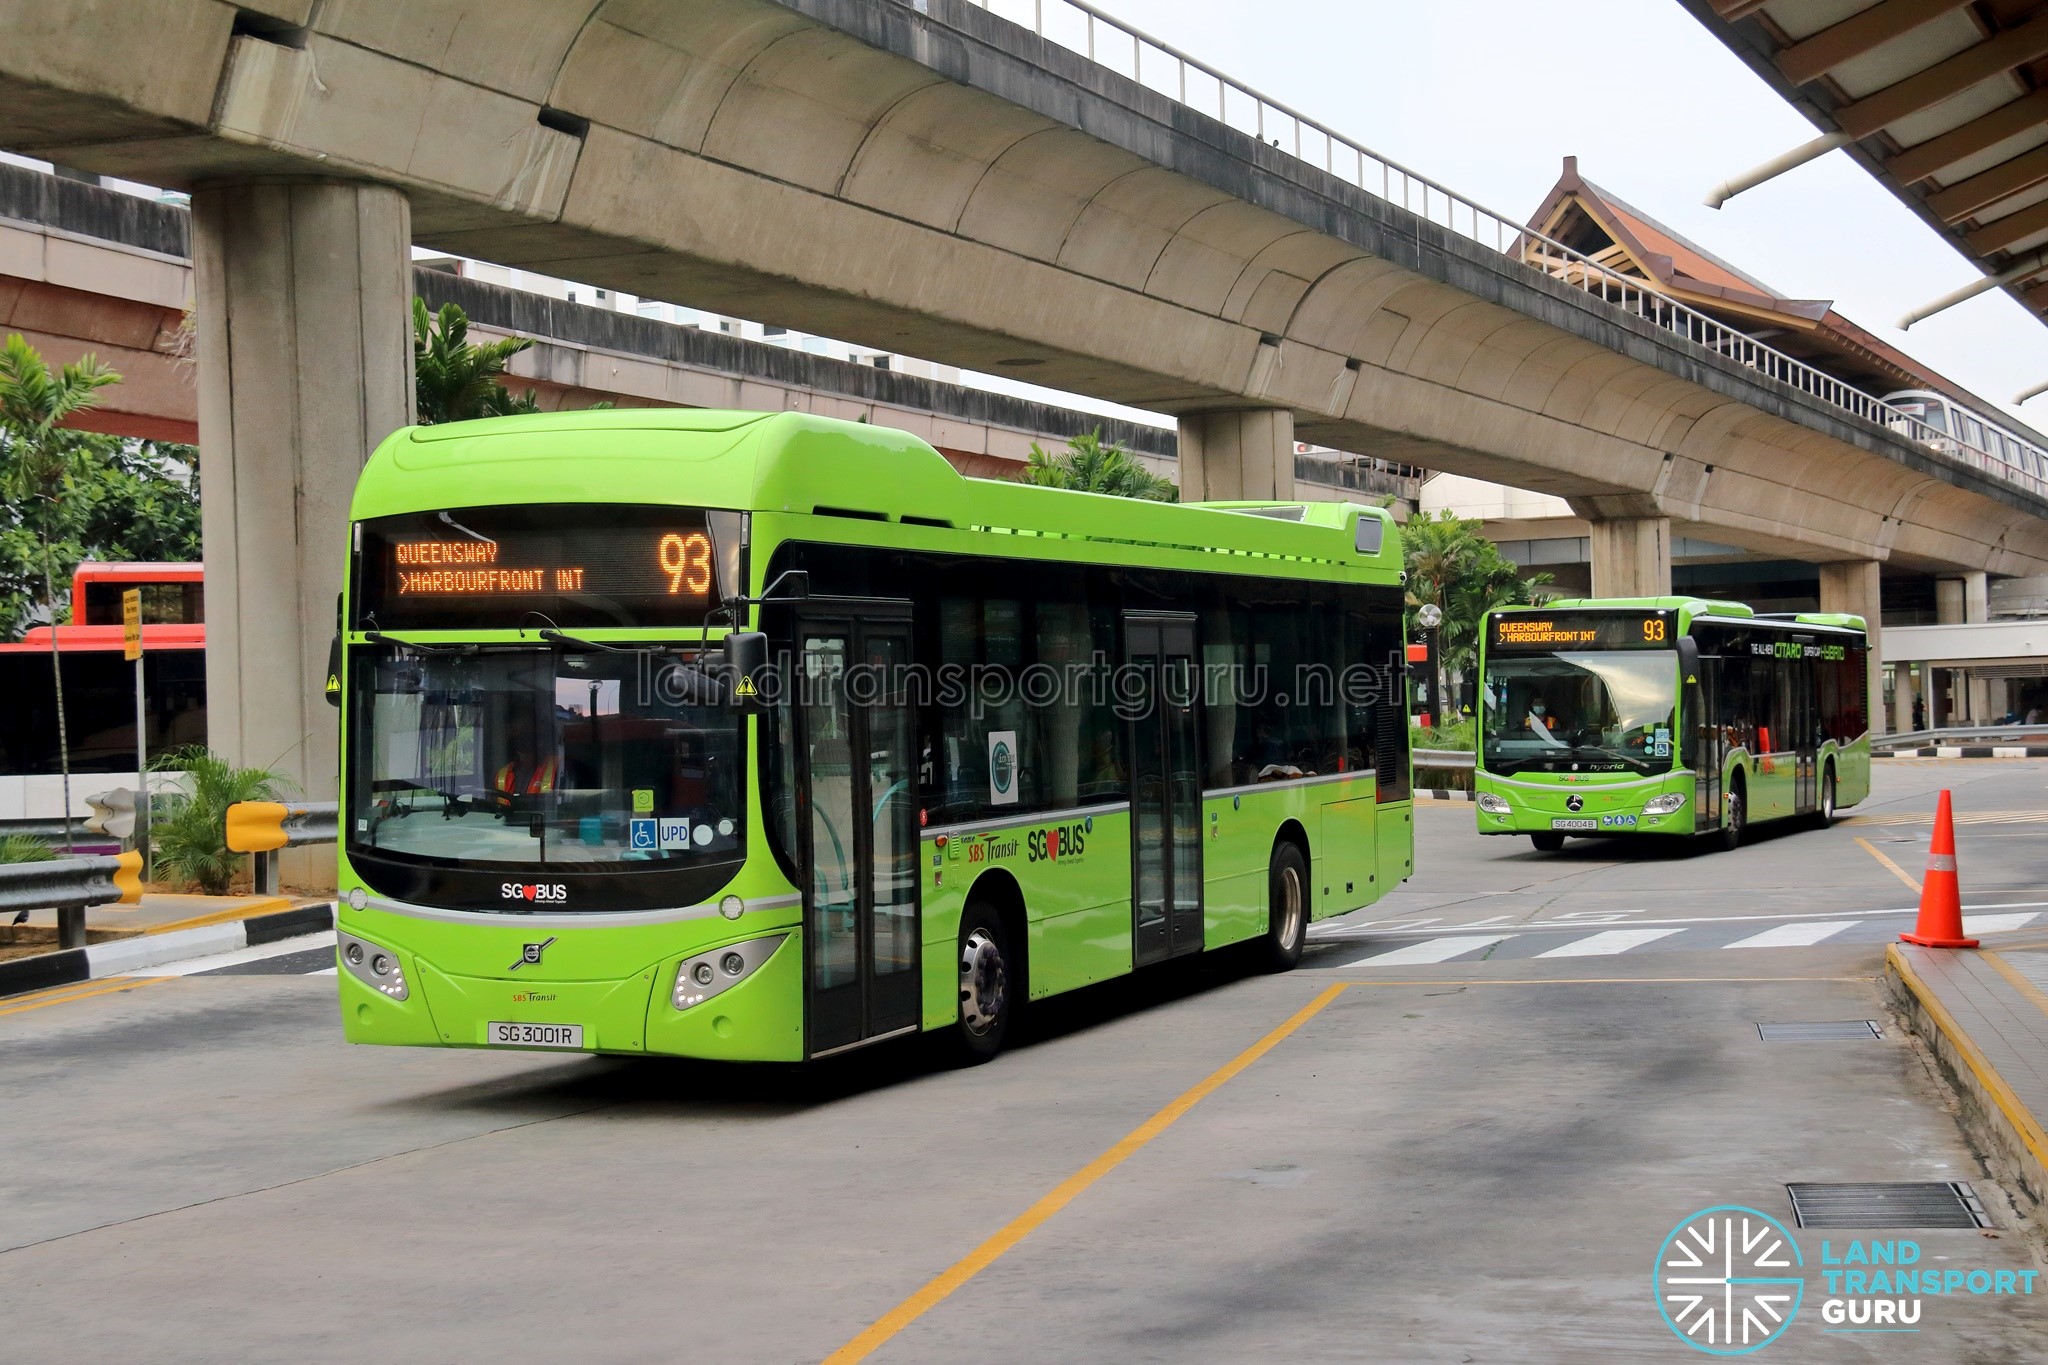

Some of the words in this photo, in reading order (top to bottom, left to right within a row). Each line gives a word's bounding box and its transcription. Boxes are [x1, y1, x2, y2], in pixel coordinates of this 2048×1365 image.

[396, 542, 498, 564] QUEENSWAY
[659, 533, 712, 594] 93
[555, 569, 584, 591] INT
[1499, 621, 1553, 632] QUEENSWAY
[1643, 619, 1665, 641] 93
[1506, 631, 1578, 642] HARBOURFRONT
[1580, 631, 1596, 641] INT
[1774, 642, 1802, 658] CITARO
[1820, 645, 1844, 660] HYBRID
[1590, 763, 1625, 771] hybrid
[1555, 820, 1594, 828] SG4004B
[661, 826, 688, 842] UPD
[968, 843, 985, 863] SBS
[983, 836, 1020, 864] Transit
[513, 994, 527, 1002] SBS
[525, 992, 558, 1002] Transit
[498, 1026, 572, 1044] SG3001R
